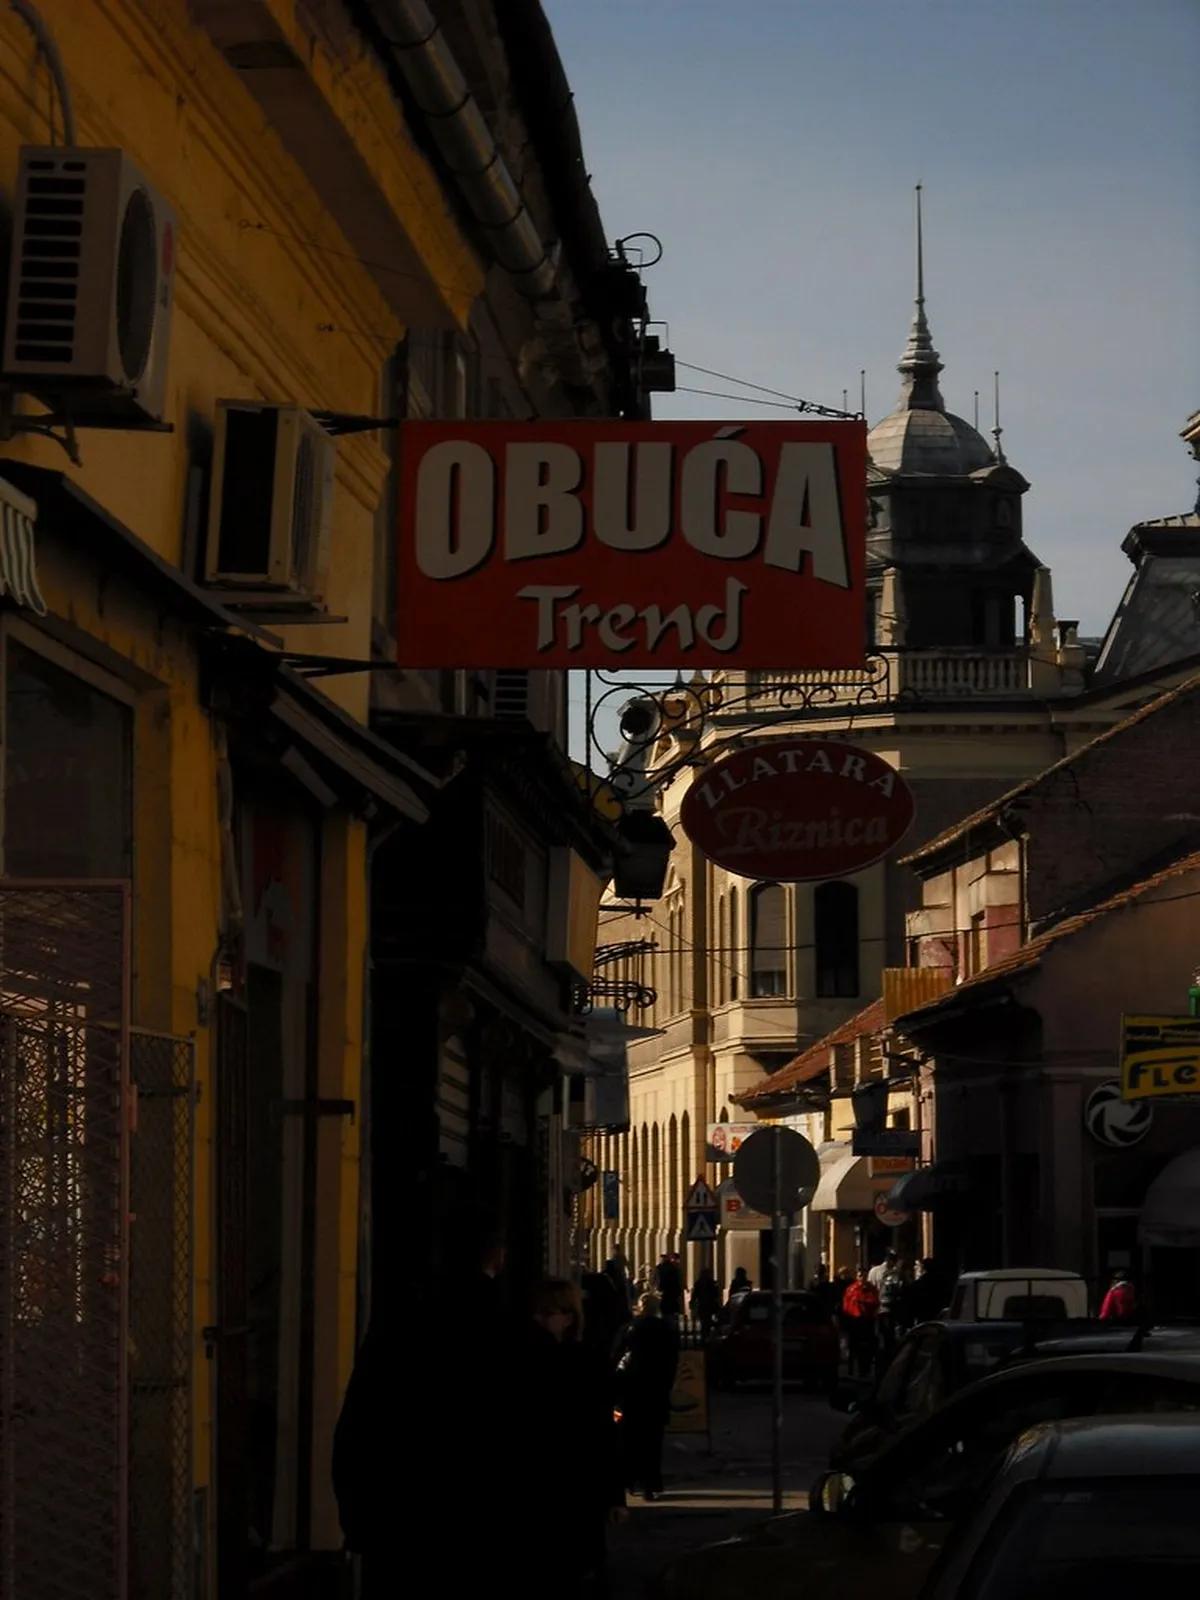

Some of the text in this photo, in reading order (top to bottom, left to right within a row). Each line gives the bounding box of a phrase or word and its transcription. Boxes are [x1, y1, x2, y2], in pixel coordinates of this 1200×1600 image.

[415, 427, 850, 590] OBUĆA
[517, 576, 750, 654] Trend
[695, 748, 896, 809] ZLATARA
[713, 805, 889, 856] Riznica
